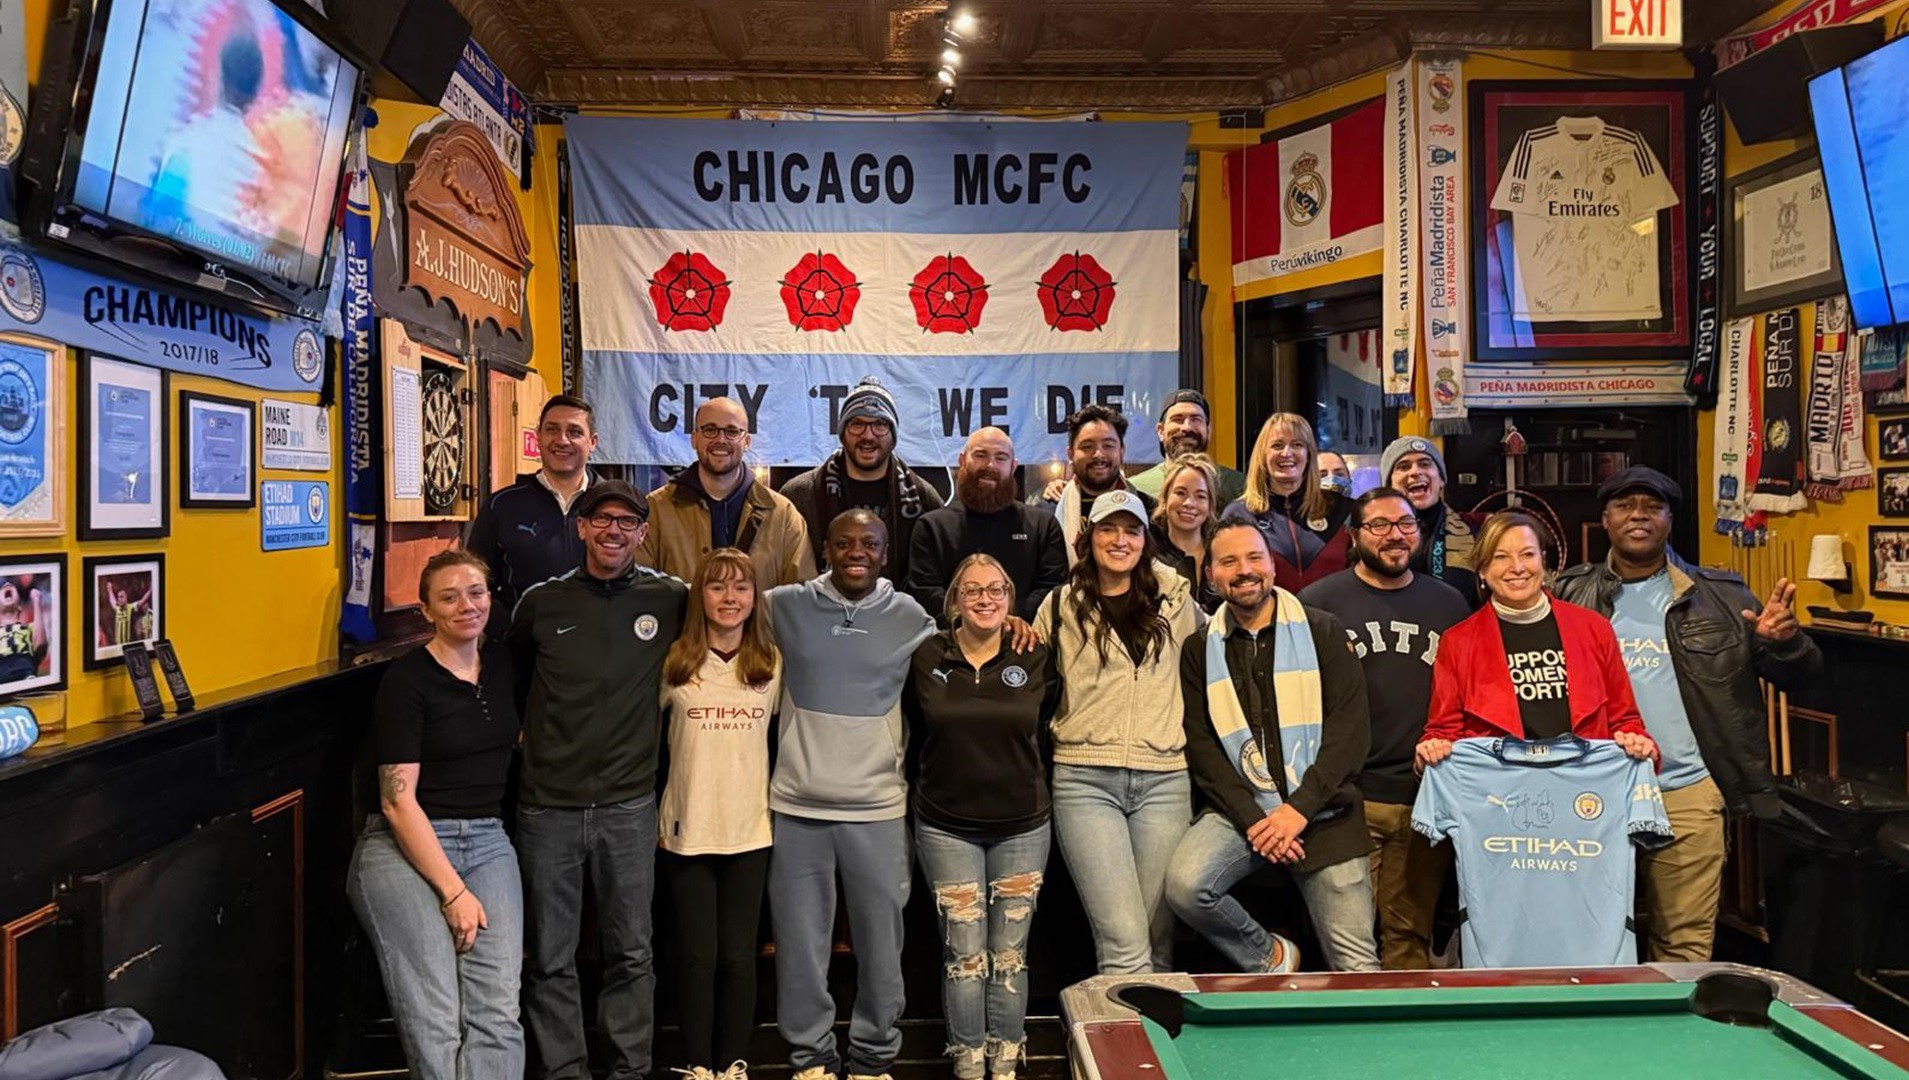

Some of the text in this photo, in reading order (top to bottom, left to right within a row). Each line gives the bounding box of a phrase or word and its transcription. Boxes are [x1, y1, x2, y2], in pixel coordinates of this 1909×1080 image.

[1610, 0, 1668, 36] EXIT
[693, 150, 1092, 205] CHICAGO MCFC
[1573, 188, 1593, 202] Fly
[1809, 183, 1823, 200] 18
[1548, 201, 1620, 217] Emirates
[1399, 208, 1409, 287] CHARLOTTE
[1446, 176, 1457, 308] SAN FRANCISCO BAY AREA
[1696, 103, 1718, 367] SUPPORT YOUR LOCAL
[84, 285, 272, 368] CHAMPIONS
[347, 301, 356, 332] DE
[160, 340, 219, 365] 2017/18
[355, 258, 372, 470] PEÑA MADRIDISTA
[1764, 331, 1779, 388] PEÑA
[1778, 337, 1793, 388] SUR
[1728, 330, 1741, 412] CHARLOTTE
[1480, 379, 1655, 392] PEÑA MADRIDISTA CHICAGO
[1809, 354, 1836, 443] MADRID
[265, 405, 291, 426] MAINE
[347, 342, 359, 484] CALIFORNIA
[938, 387, 1010, 437] WE
[1727, 414, 1736, 435] NC
[265, 427, 288, 446] ROAD
[265, 483, 294, 504] ETIHAD
[265, 505, 300, 526] STADIUM
[1346, 621, 1440, 666] CITY
[1510, 666, 1567, 684] OMEN
[1623, 657, 1660, 668] WAYS
[687, 707, 765, 720] ETIHAD
[701, 722, 752, 731] AIRWAYS
[1484, 836, 1603, 857] ETIHAD
[1511, 858, 1577, 872] AIRWAYS
